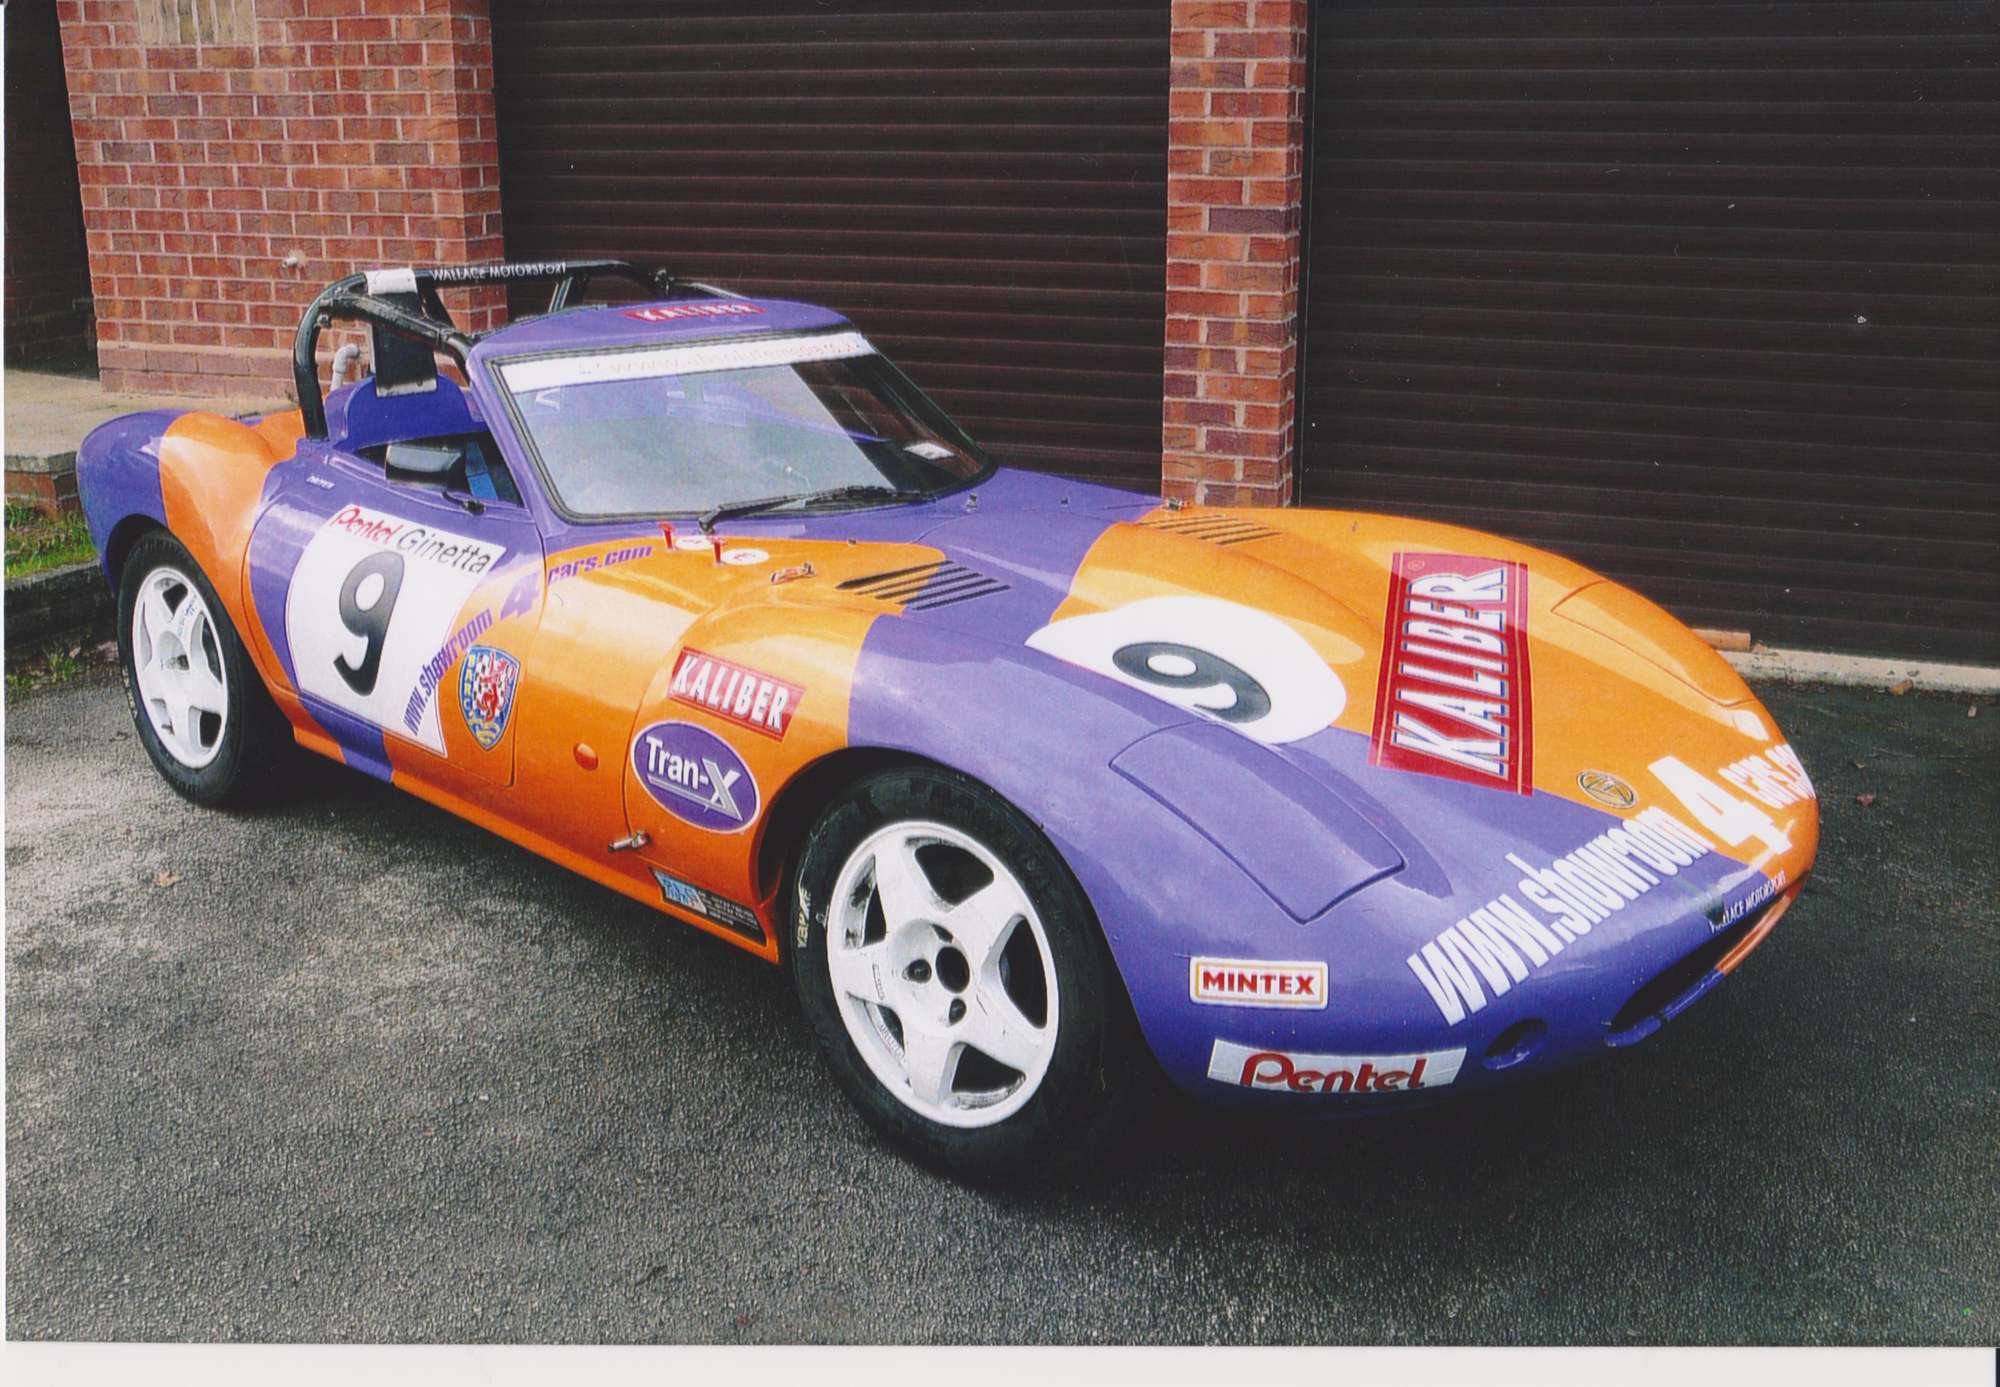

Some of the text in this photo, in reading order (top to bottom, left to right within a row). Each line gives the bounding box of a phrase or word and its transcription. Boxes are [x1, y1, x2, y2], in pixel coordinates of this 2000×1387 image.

[330, 506, 491, 574] Pentel Ginetta
[333, 550, 406, 697] 9
[671, 655, 790, 732] KALIBER
[1112, 641, 1272, 724] 9
[1391, 567, 1510, 781] KALIBER
[645, 735, 744, 822] Tran-X
[1202, 970, 1316, 995] MINTEX
[1239, 1051, 1429, 1093] Pentel
